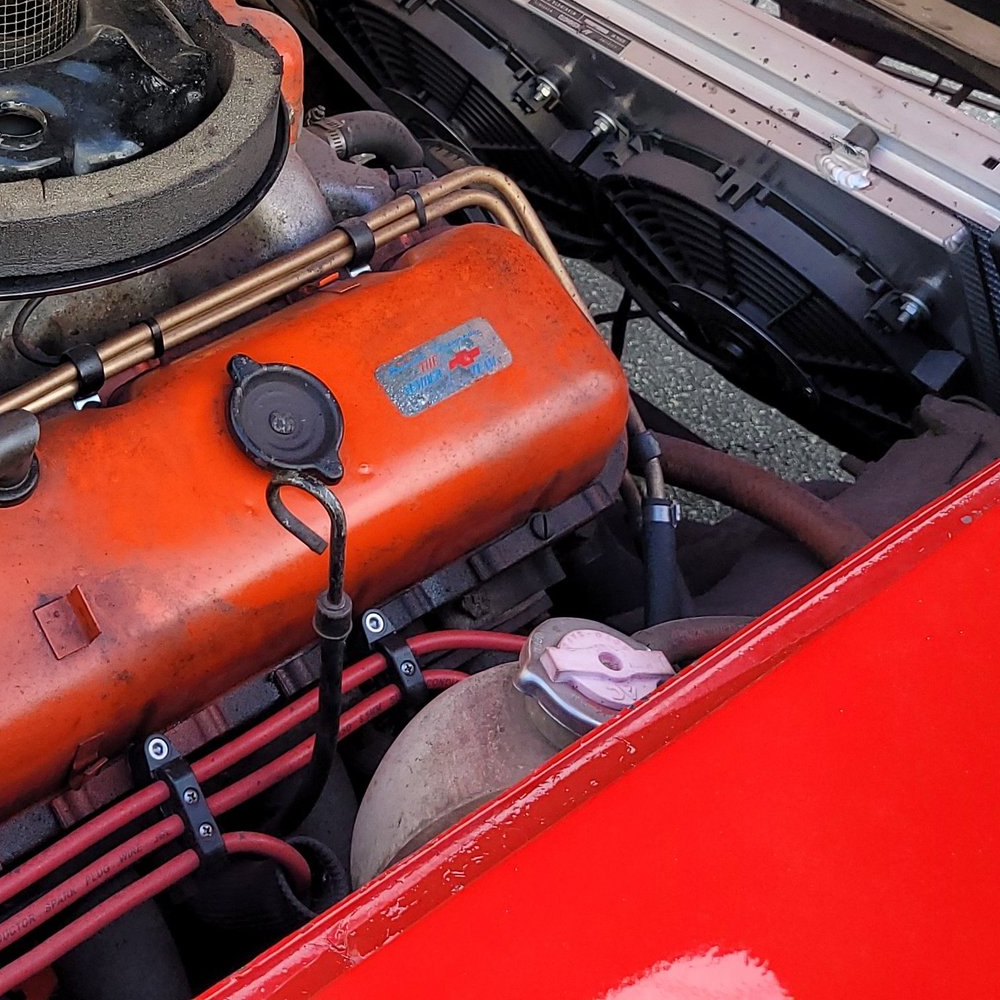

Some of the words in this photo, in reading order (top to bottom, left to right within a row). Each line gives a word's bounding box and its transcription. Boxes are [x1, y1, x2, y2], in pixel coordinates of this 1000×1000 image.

[44, 888, 77, 913] SPARK
[85, 865, 111, 886] PLUG
[118, 844, 142, 863] WIRE
